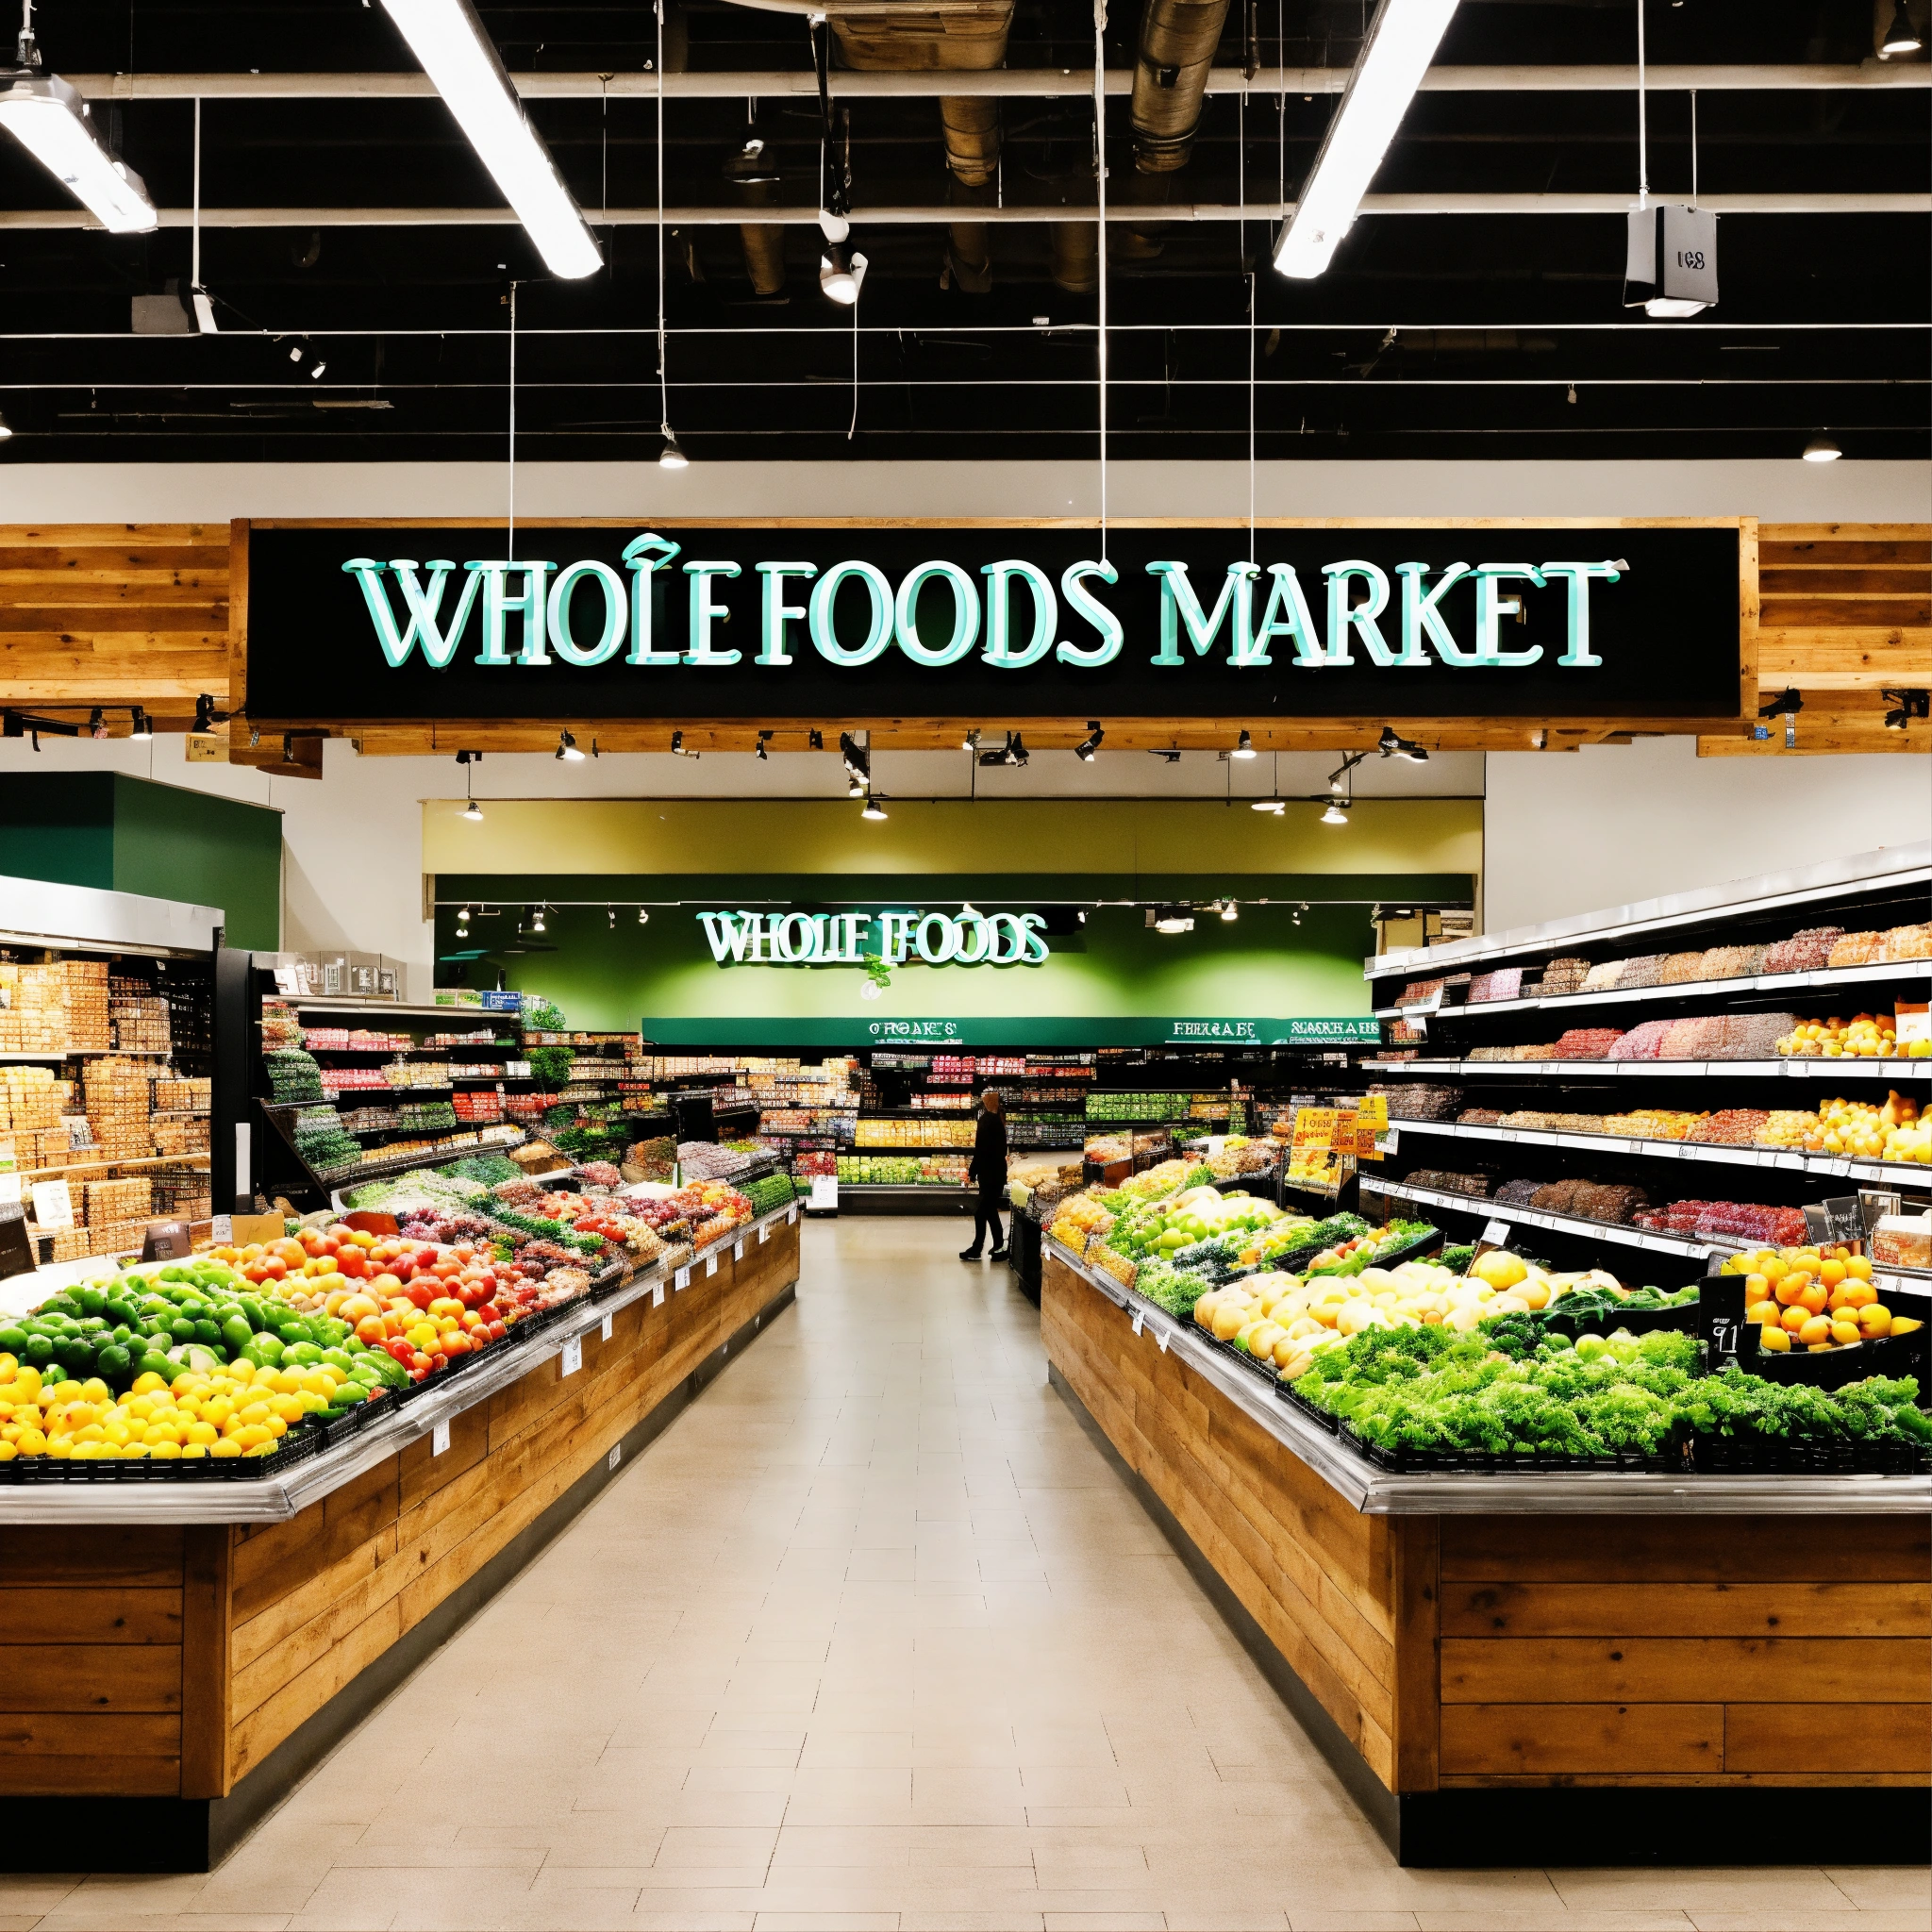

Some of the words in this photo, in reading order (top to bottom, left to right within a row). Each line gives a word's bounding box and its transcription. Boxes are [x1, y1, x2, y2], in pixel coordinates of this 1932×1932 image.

[341, 558, 742, 667] WHOLE
[755, 559, 1124, 668] FOODS
[1145, 560, 1621, 667] MARKET
